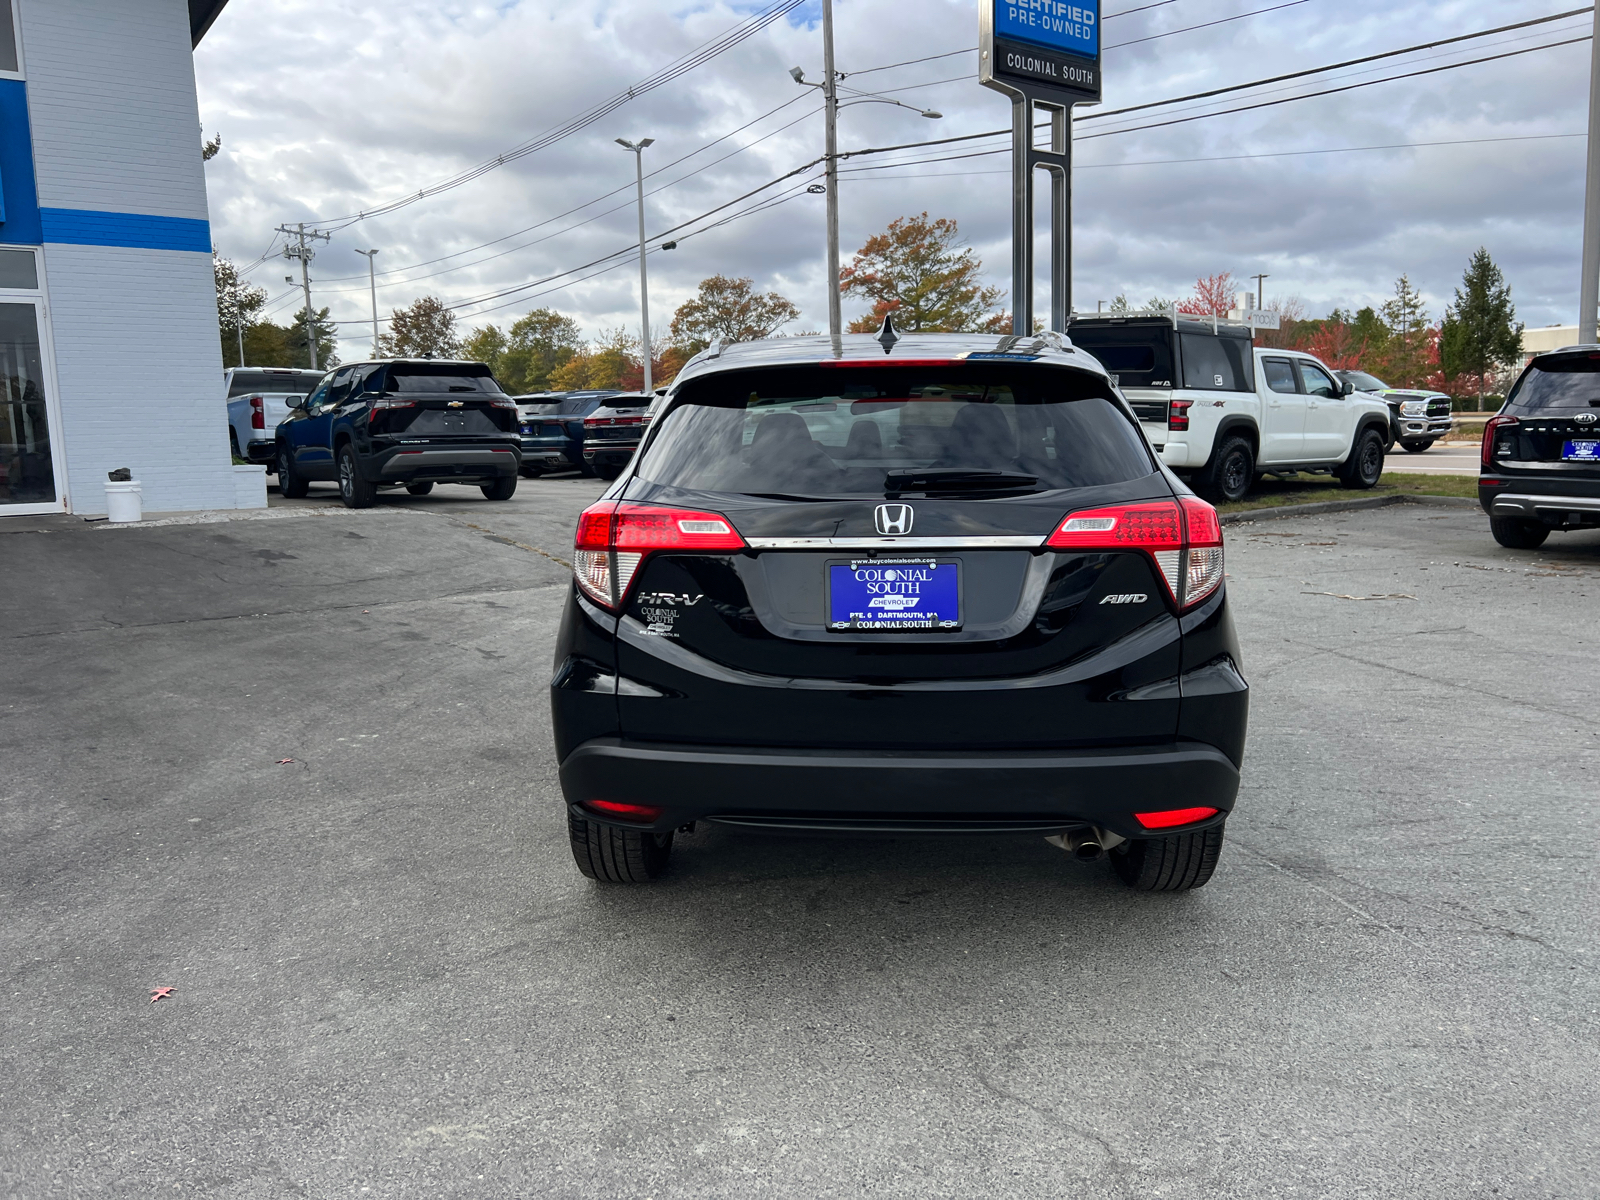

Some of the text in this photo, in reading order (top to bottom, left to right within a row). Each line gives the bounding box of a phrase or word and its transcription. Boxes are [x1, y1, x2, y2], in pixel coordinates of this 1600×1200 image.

[1009, 6, 1091, 40] PRE-OWNED
[1007, 53, 1093, 84] COLONIAL SOUTH
[855, 569, 933, 582] COLONIAL
[866, 582, 921, 594] SOUTH
[637, 592, 704, 606] HR-V
[1099, 593, 1148, 605] AWD
[641, 607, 680, 618] COLONIAL
[646, 615, 674, 624] SOUTH
[856, 620, 933, 629] COLONIAL SOUTH
